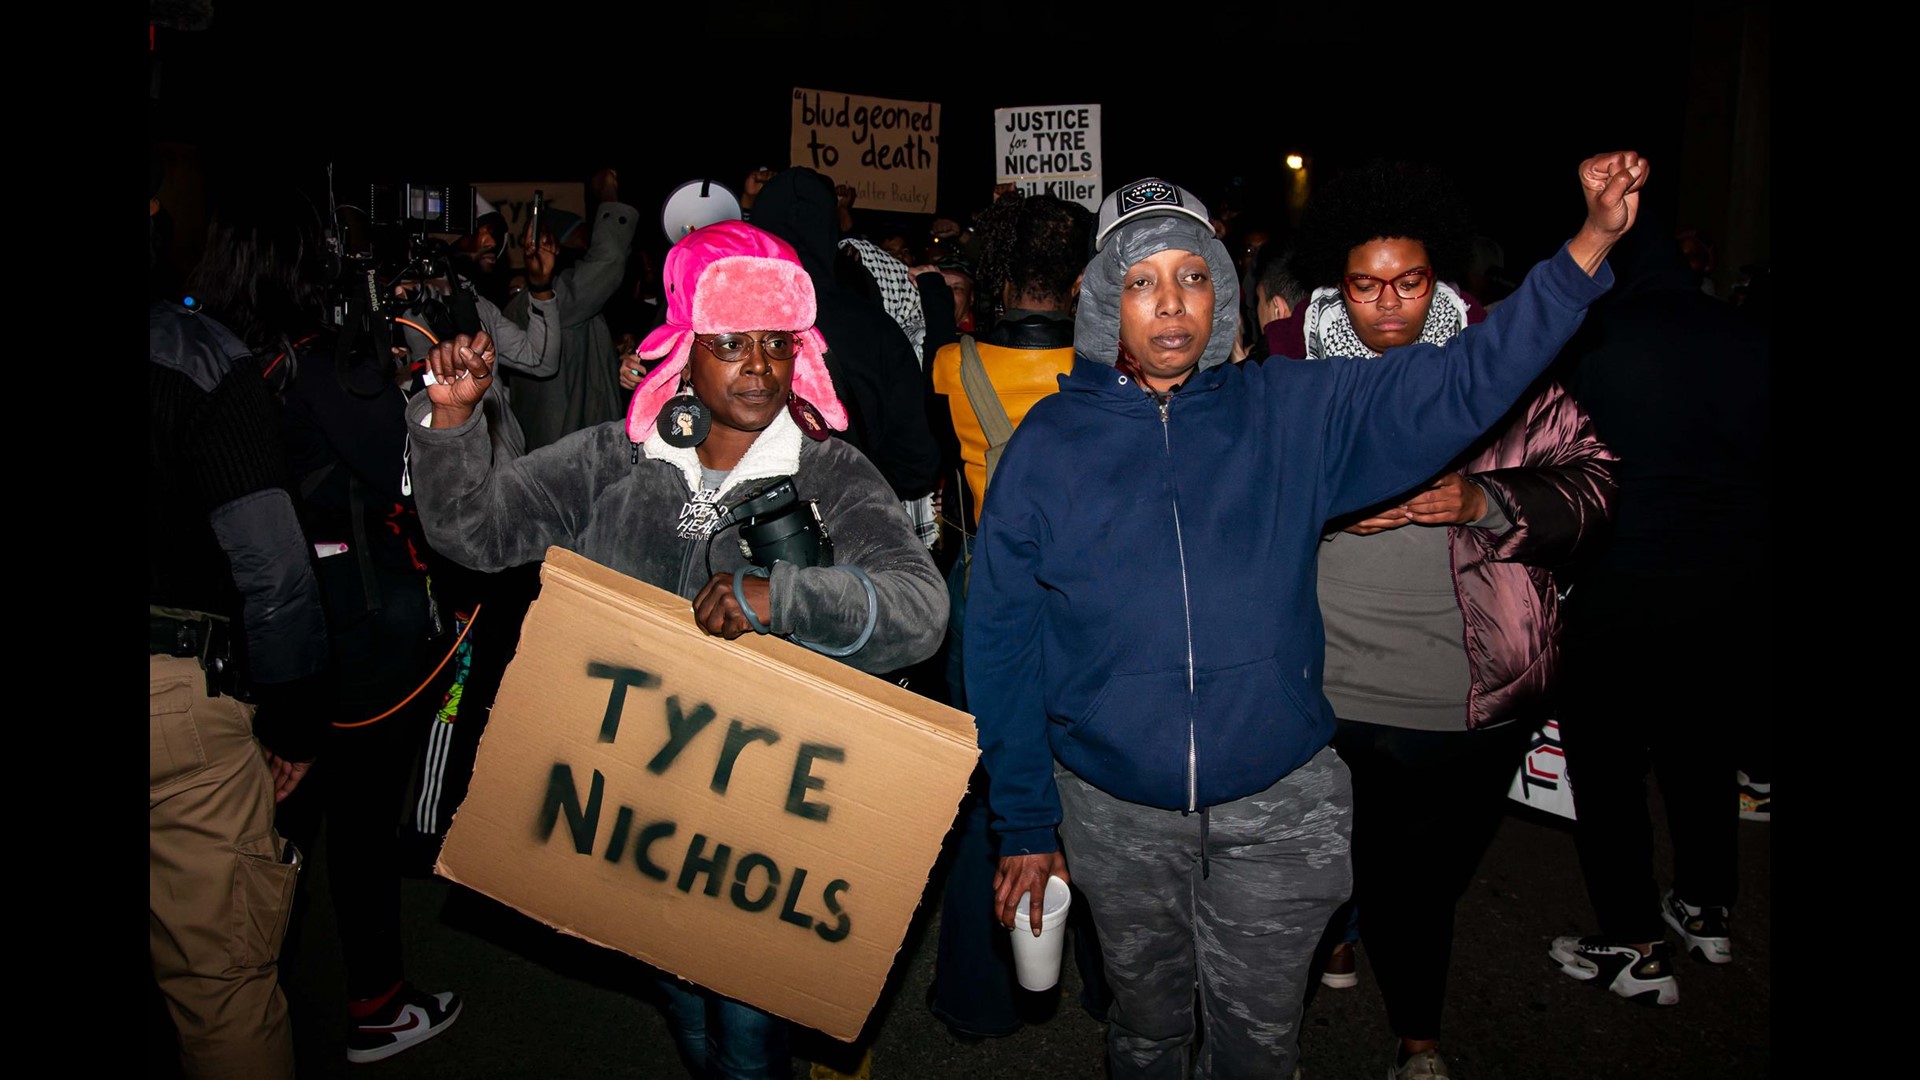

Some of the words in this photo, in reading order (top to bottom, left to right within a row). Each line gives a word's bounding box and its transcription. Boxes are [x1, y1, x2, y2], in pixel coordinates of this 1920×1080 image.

[1005, 109, 1089, 132] JUSTICE
[807, 129, 839, 169] to
[1009, 133, 1027, 155] for
[1033, 131, 1086, 152] TYRE
[1005, 152, 1092, 175] NICHOLS
[1016, 182, 1037, 199] ail
[367, 269, 380, 312] Panasonic
[531, 762, 851, 943] NICHOLS
